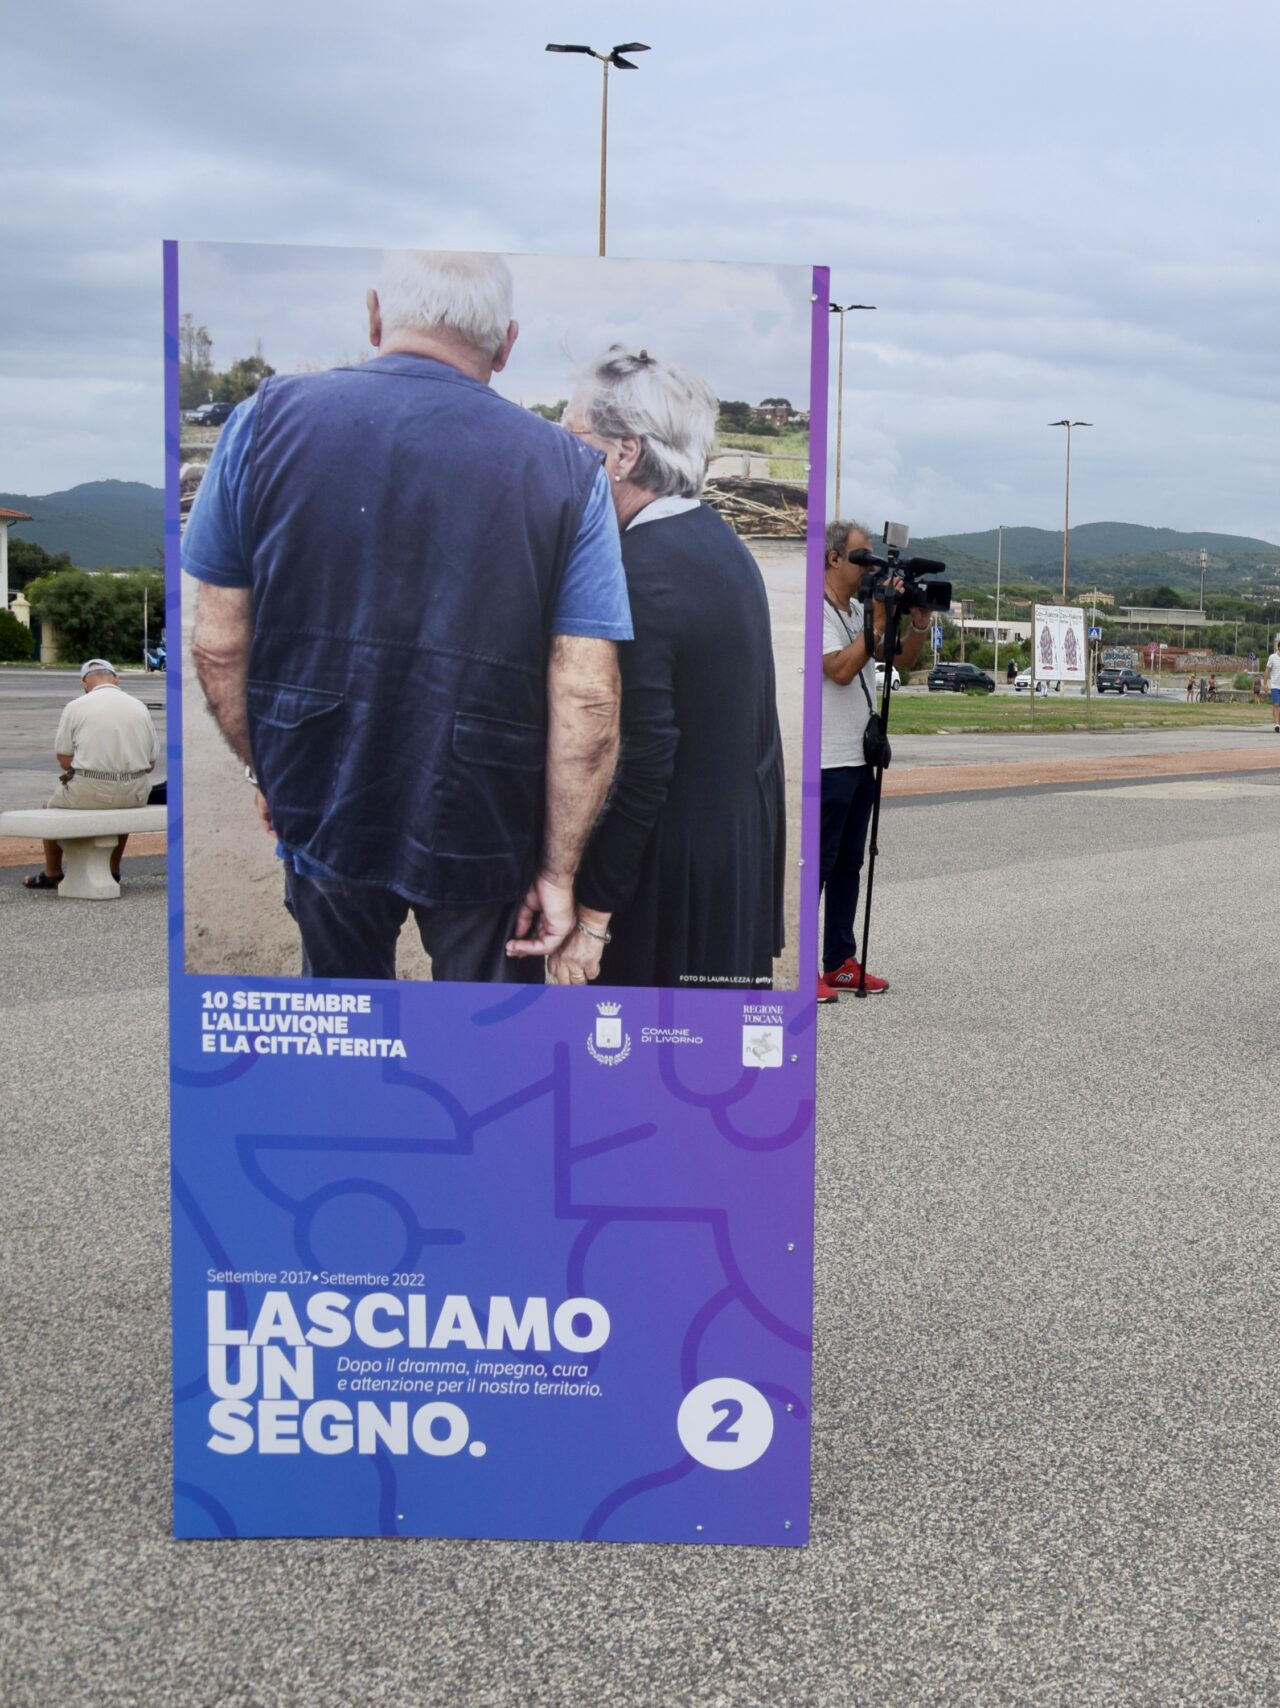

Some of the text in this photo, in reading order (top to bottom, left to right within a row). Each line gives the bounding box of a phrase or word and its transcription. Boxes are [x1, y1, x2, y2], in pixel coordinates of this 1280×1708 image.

[679, 974, 698, 982] FOTO
[699, 975, 707, 983] DI
[707, 975, 730, 984] LAURA
[730, 976, 751, 984] LEZZA
[201, 990, 372, 1014] 10 SETTEMBRE
[743, 1004, 784, 1014] REGIONE
[201, 1012, 349, 1035] L'ALLUVIONE
[743, 1014, 784, 1024] TOSCANA
[641, 1027, 690, 1037] COMUNE
[641, 1035, 704, 1044] DI LIVORNO
[201, 1032, 408, 1058] E LA CITTÀ FERITA
[206, 1268, 277, 1284] Settembre
[392, 1273, 425, 1287] 2022
[207, 1290, 611, 1352] LASCIAMO
[206, 1345, 314, 1400] UN
[336, 1356, 589, 1379] Dopo il dramma, impegno, cura
[337, 1377, 603, 1397] e attenzione per il nostro territorio.
[206, 1400, 487, 1457] SEGNO.
[705, 1398, 744, 1443] 2
